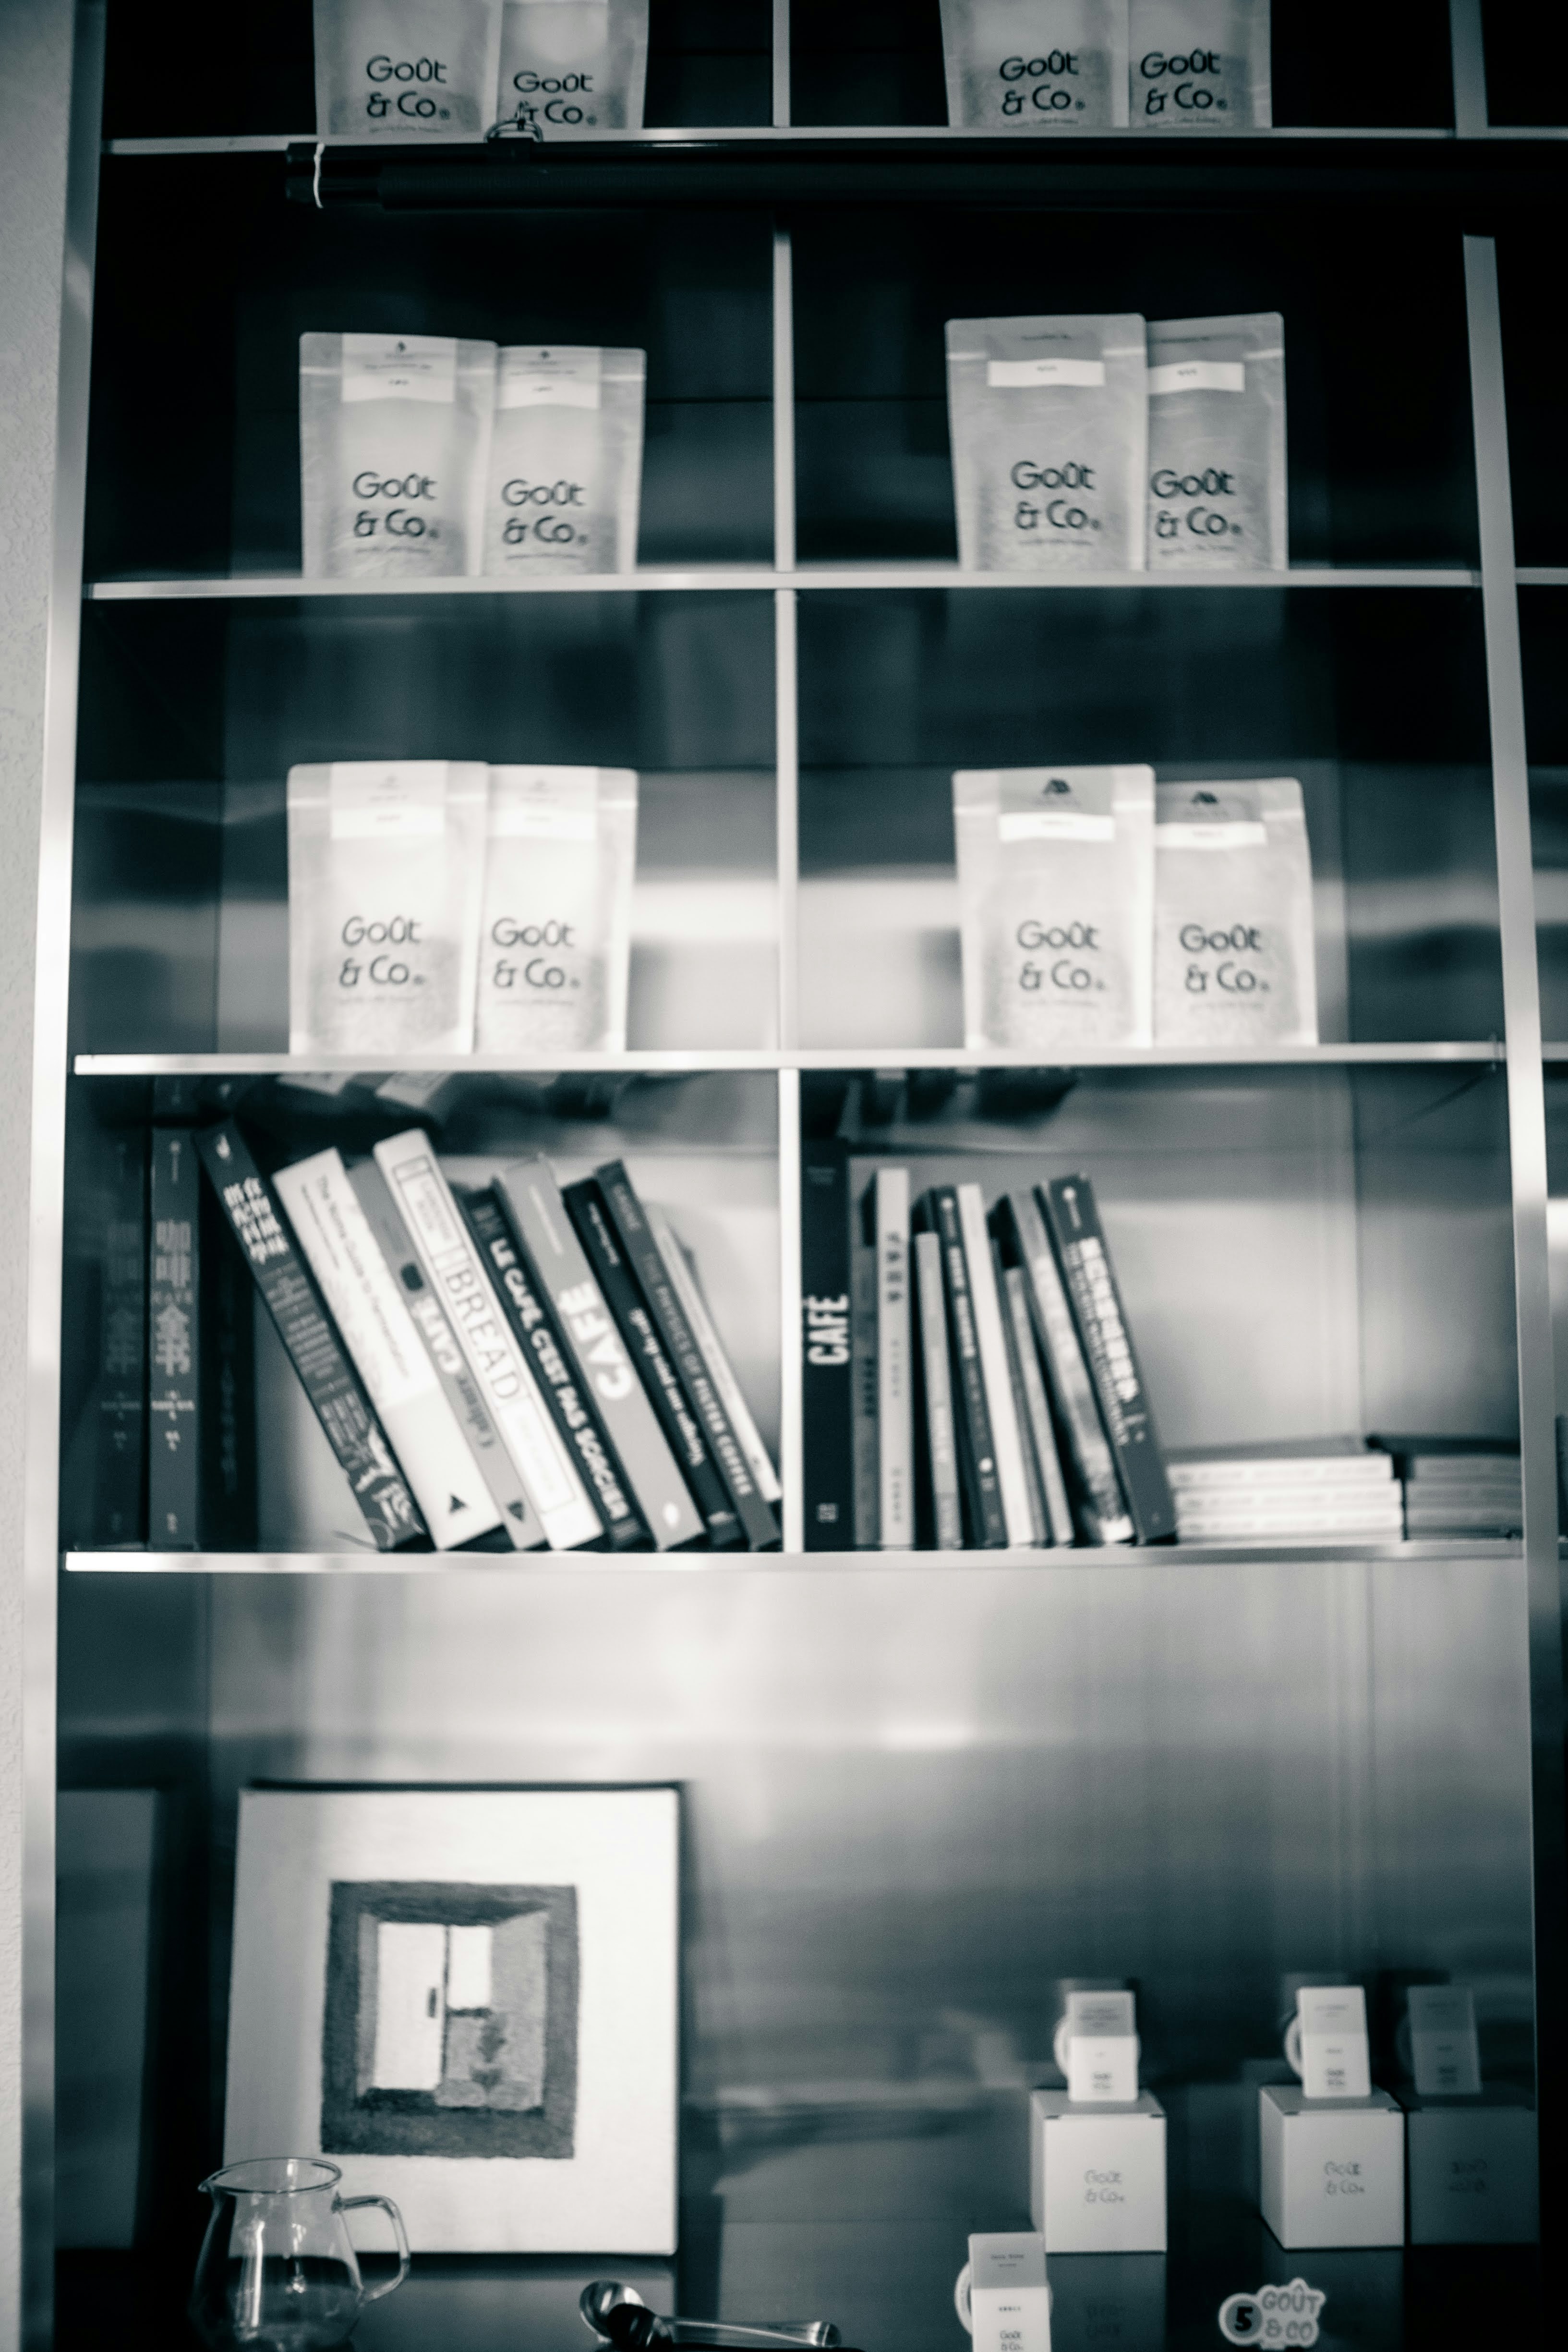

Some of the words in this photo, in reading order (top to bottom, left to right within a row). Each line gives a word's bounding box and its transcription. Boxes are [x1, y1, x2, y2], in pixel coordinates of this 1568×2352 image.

[366, 92, 391, 118] &
[1002, 89, 1026, 116] &
[1146, 88, 1169, 115] &
[353, 510, 378, 538] &
[1014, 501, 1038, 530] &
[1155, 510, 1179, 538] &
[502, 517, 529, 545] &
[339, 957, 363, 988] &
[493, 960, 518, 988] &
[1019, 961, 1042, 991] &
[1184, 963, 1206, 993] &
[441, 1264, 527, 1405] BREAD
[551, 1276, 643, 1407] CAFÉ
[487, 1235, 518, 1269] LE
[553, 1383, 590, 1430] PAS
[572, 1425, 631, 1522] SORCIER
[1262, 2283, 1319, 2315] GOÛT
[1235, 2306, 1253, 2331] 5
[1285, 2320, 1313, 2341] CO
